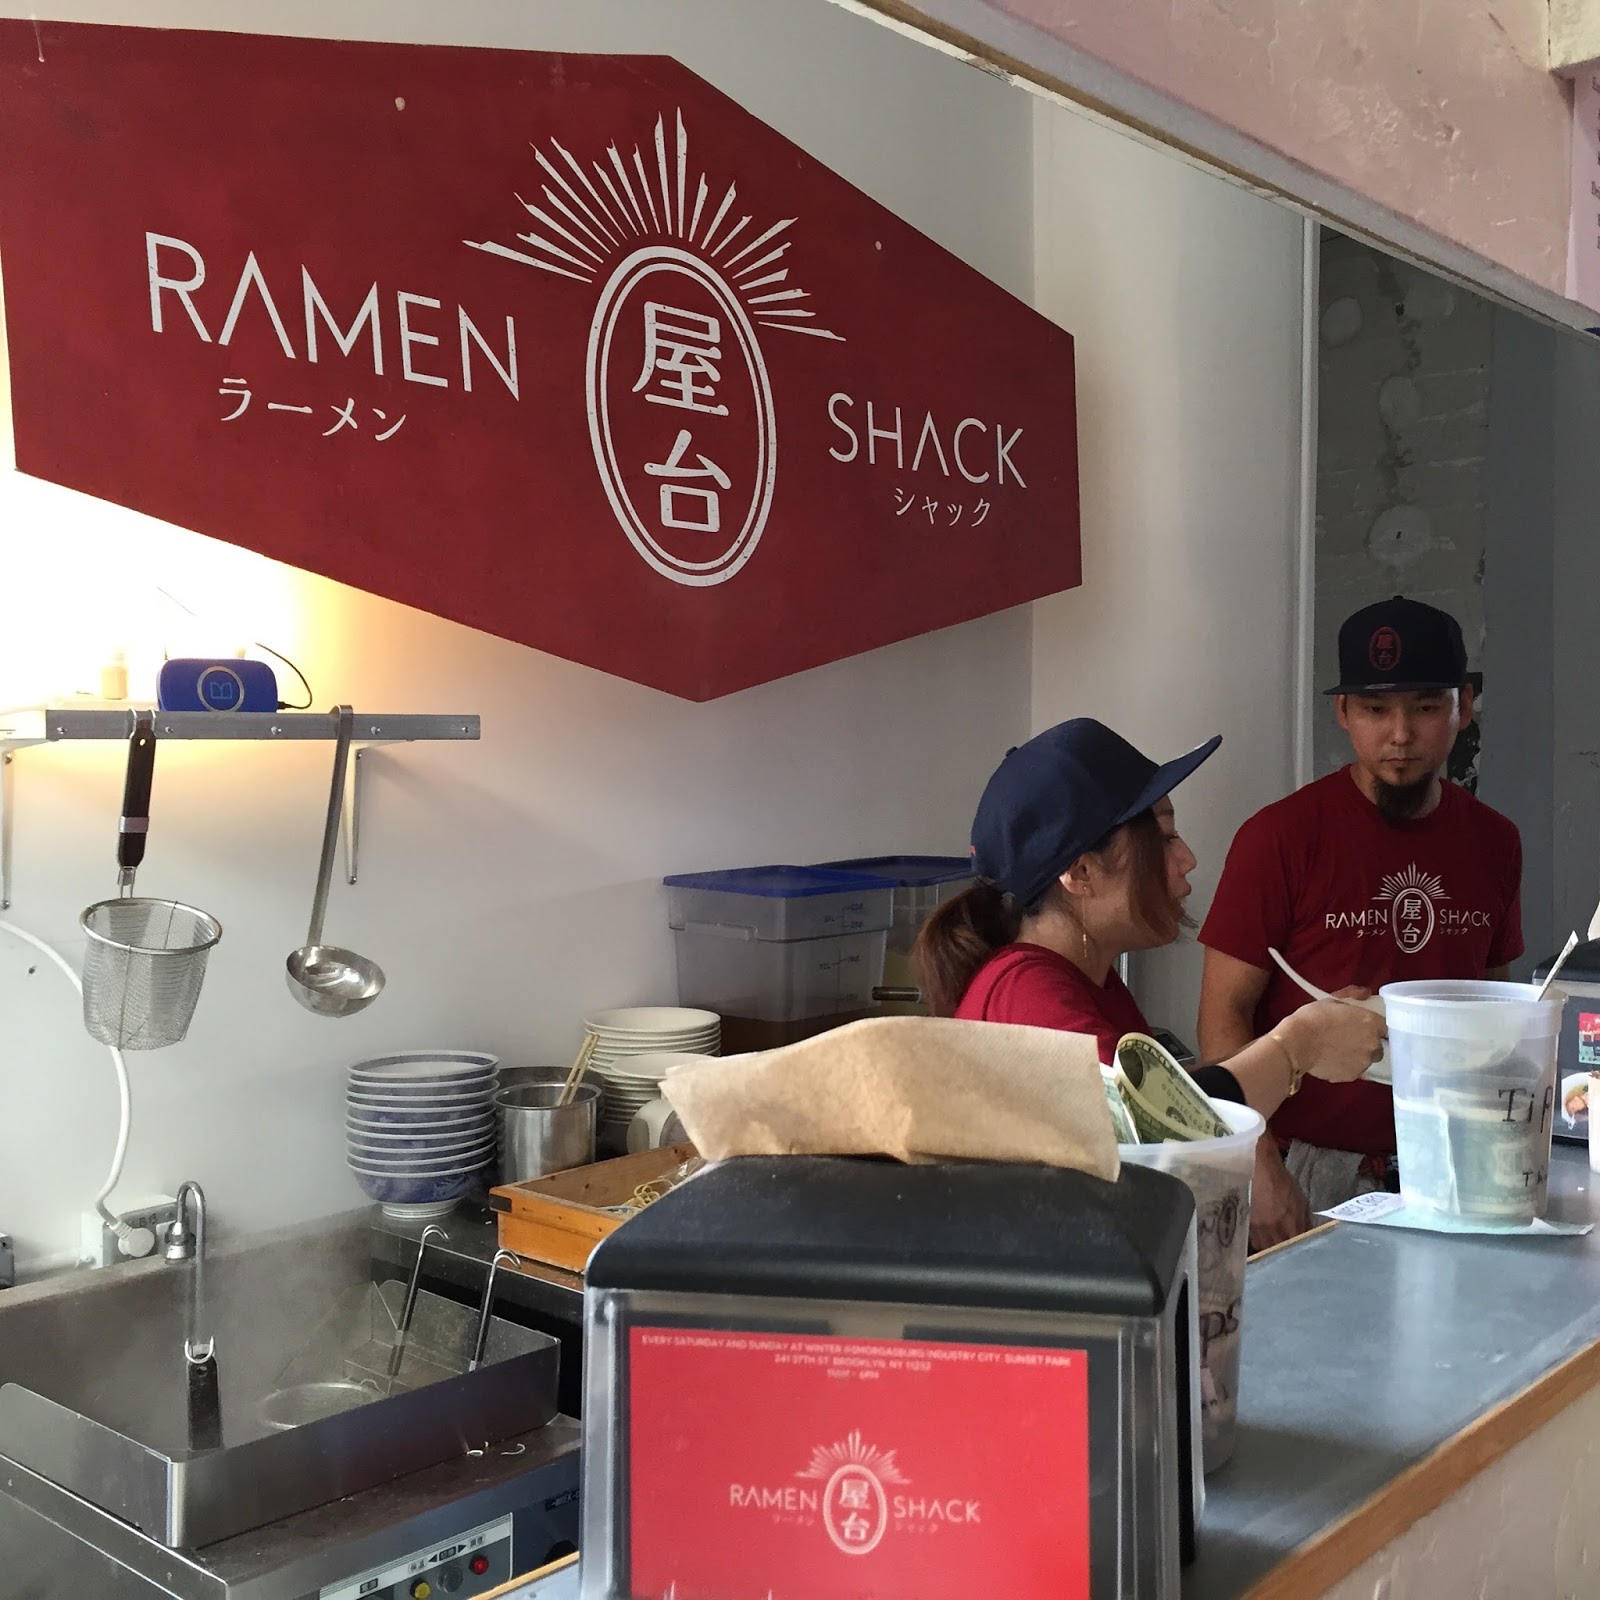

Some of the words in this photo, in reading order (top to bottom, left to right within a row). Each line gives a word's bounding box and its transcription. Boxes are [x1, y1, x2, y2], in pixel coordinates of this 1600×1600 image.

[145, 231, 519, 401] RAMEN
[218, 377, 406, 441] ラーメン
[632, 301, 731, 534] 屋台
[827, 392, 1027, 489] SHACK
[893, 487, 991, 528] シャック
[1325, 909, 1388, 929] RAMEN
[1439, 908, 1491, 927] SHACK
[1401, 898, 1422, 944] 屋台
[642, 1335, 672, 1345] EVERY
[674, 1336, 724, 1348] SATURDAY
[726, 1339, 748, 1349] AND
[748, 1340, 788, 1351] SUNDAY
[790, 1342, 802, 1352] AT
[1005, 1353, 1044, 1364] SUNSET
[1045, 1355, 1071, 1365] PARK
[729, 1483, 818, 1512] RAMEN
[893, 1495, 982, 1524] SHACK
